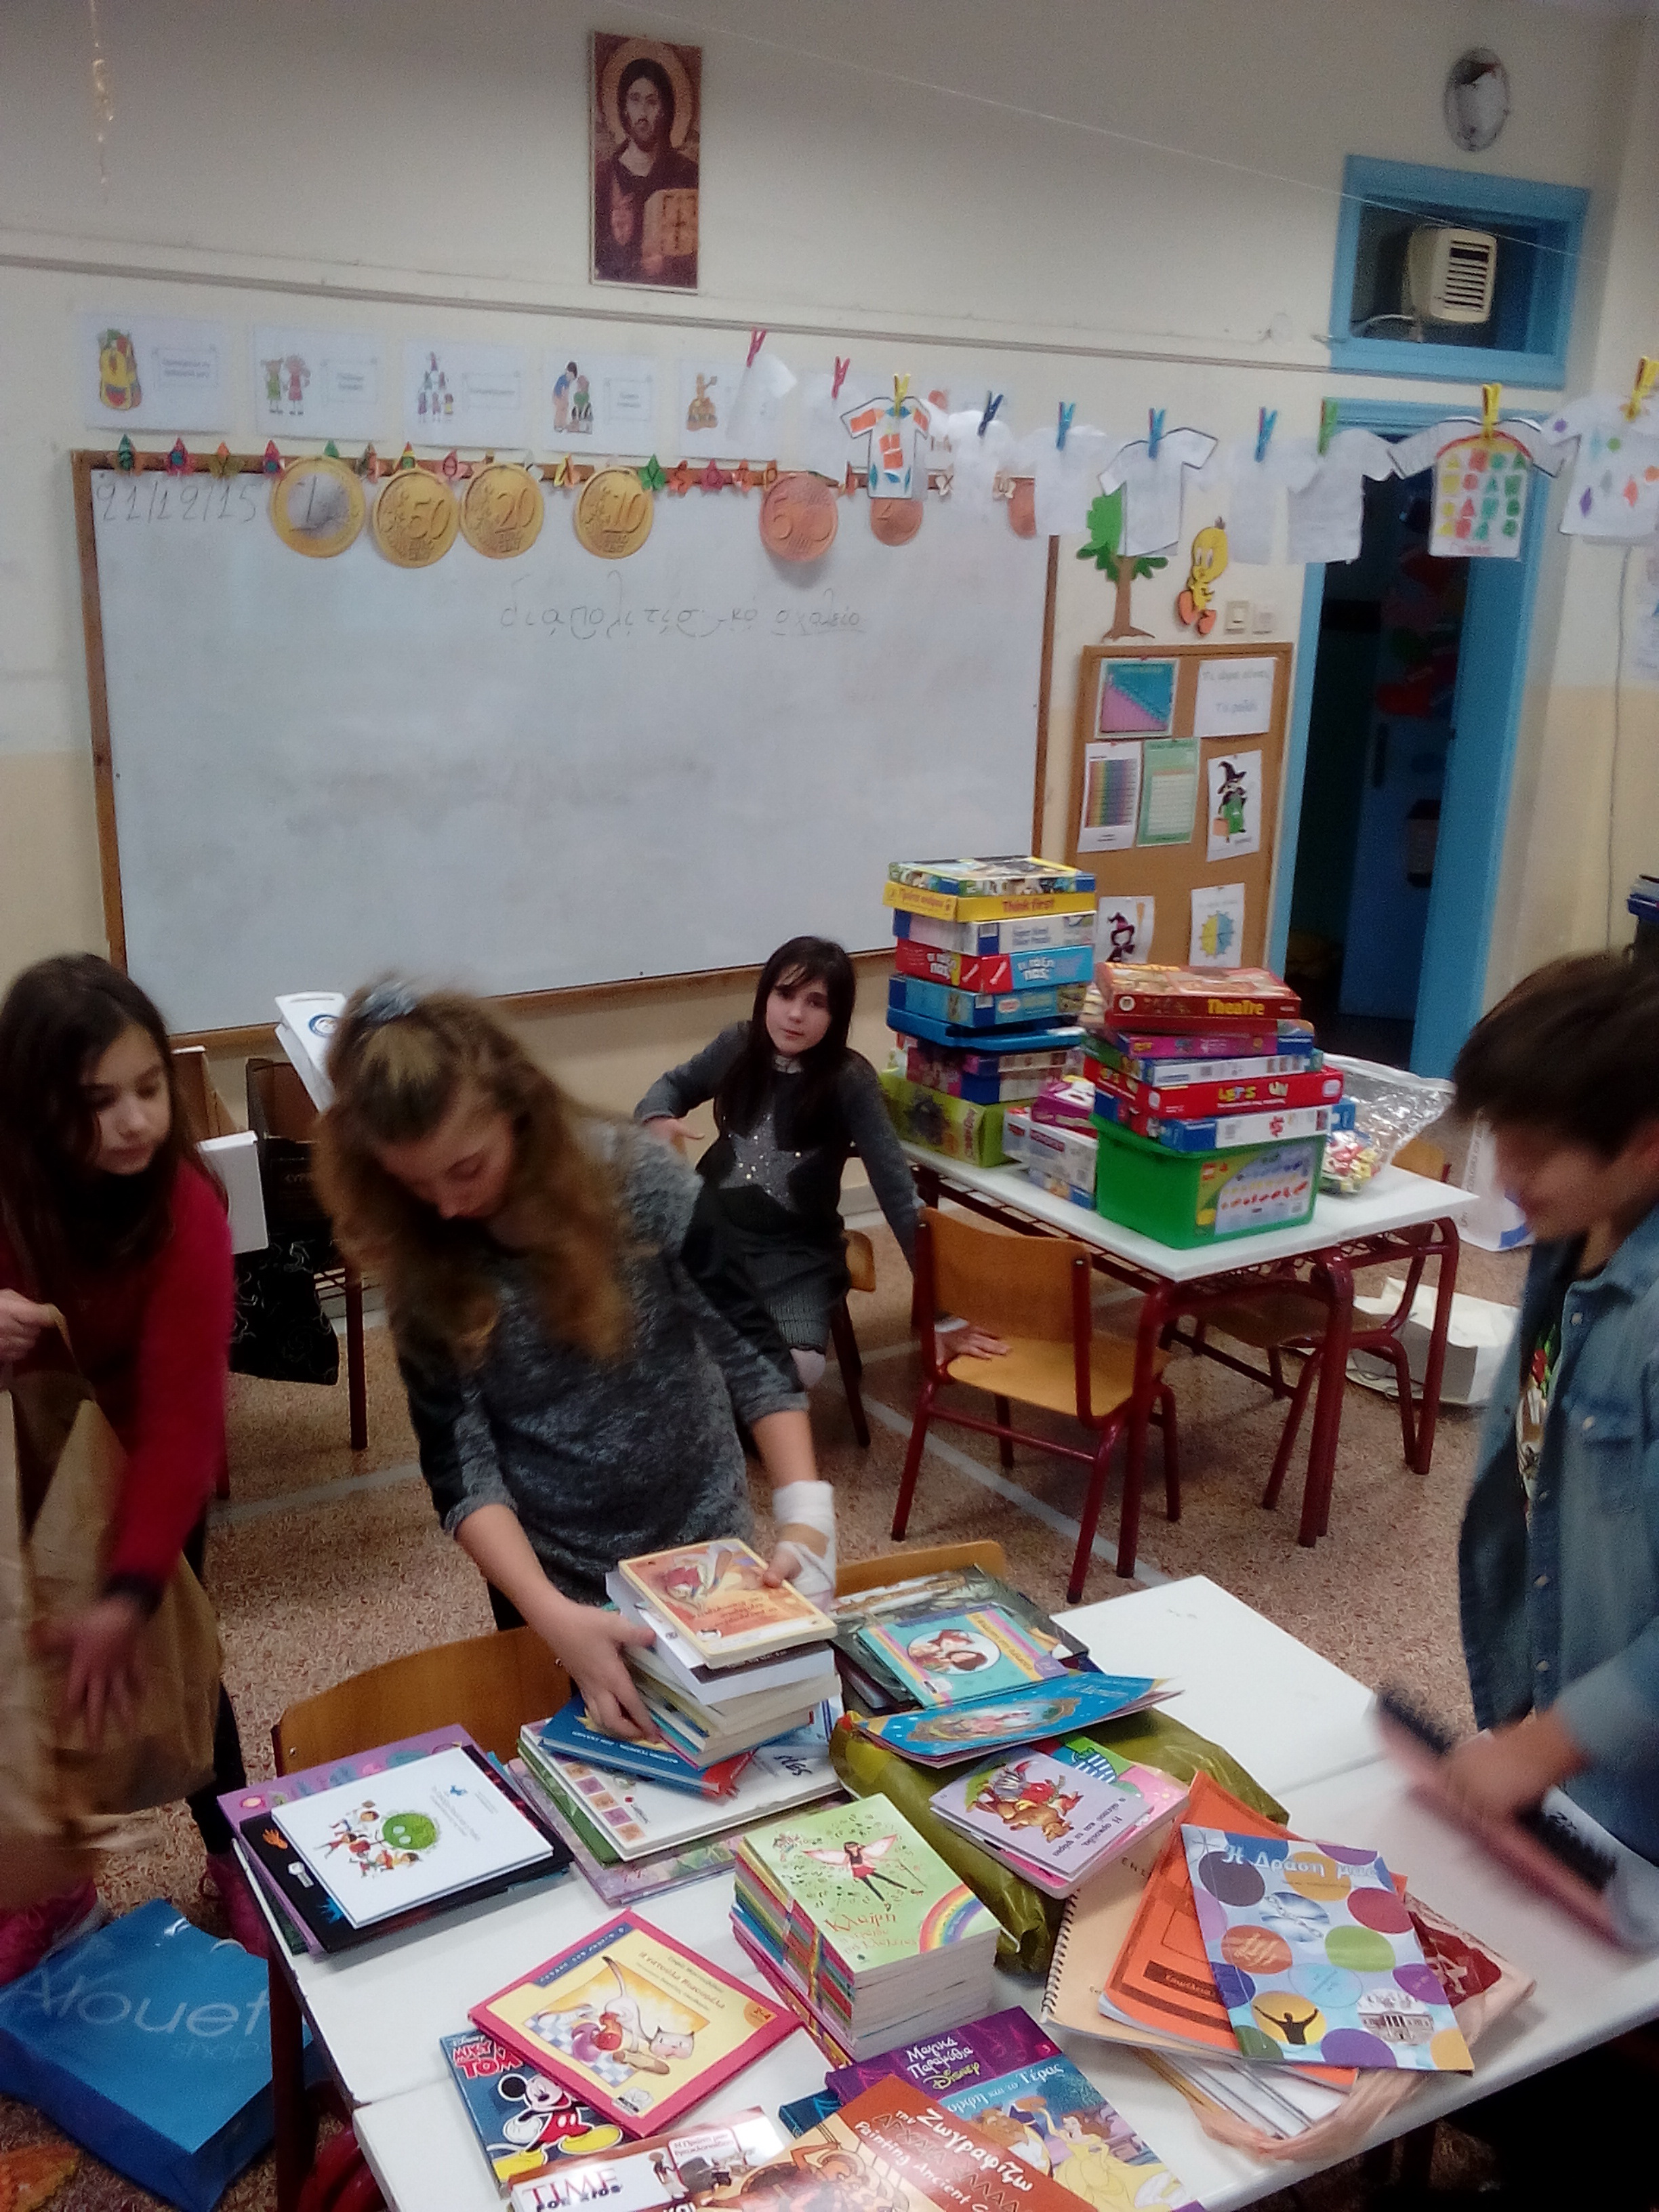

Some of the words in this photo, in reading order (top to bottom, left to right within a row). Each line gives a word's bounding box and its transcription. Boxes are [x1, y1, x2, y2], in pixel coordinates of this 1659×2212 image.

[407, 499, 451, 540] 50
[494, 488, 537, 534] 20
[602, 493, 647, 533] 10
[906, 2036, 958, 2063] Μαγικά
[1017, 2063, 1065, 2085] Τέρας
[855, 2121, 911, 2166] Painting
[914, 2161, 972, 2205] Ancient
[916, 2108, 1034, 2192] Ζωγραφίζω
[522, 2167, 618, 2205] TIME
